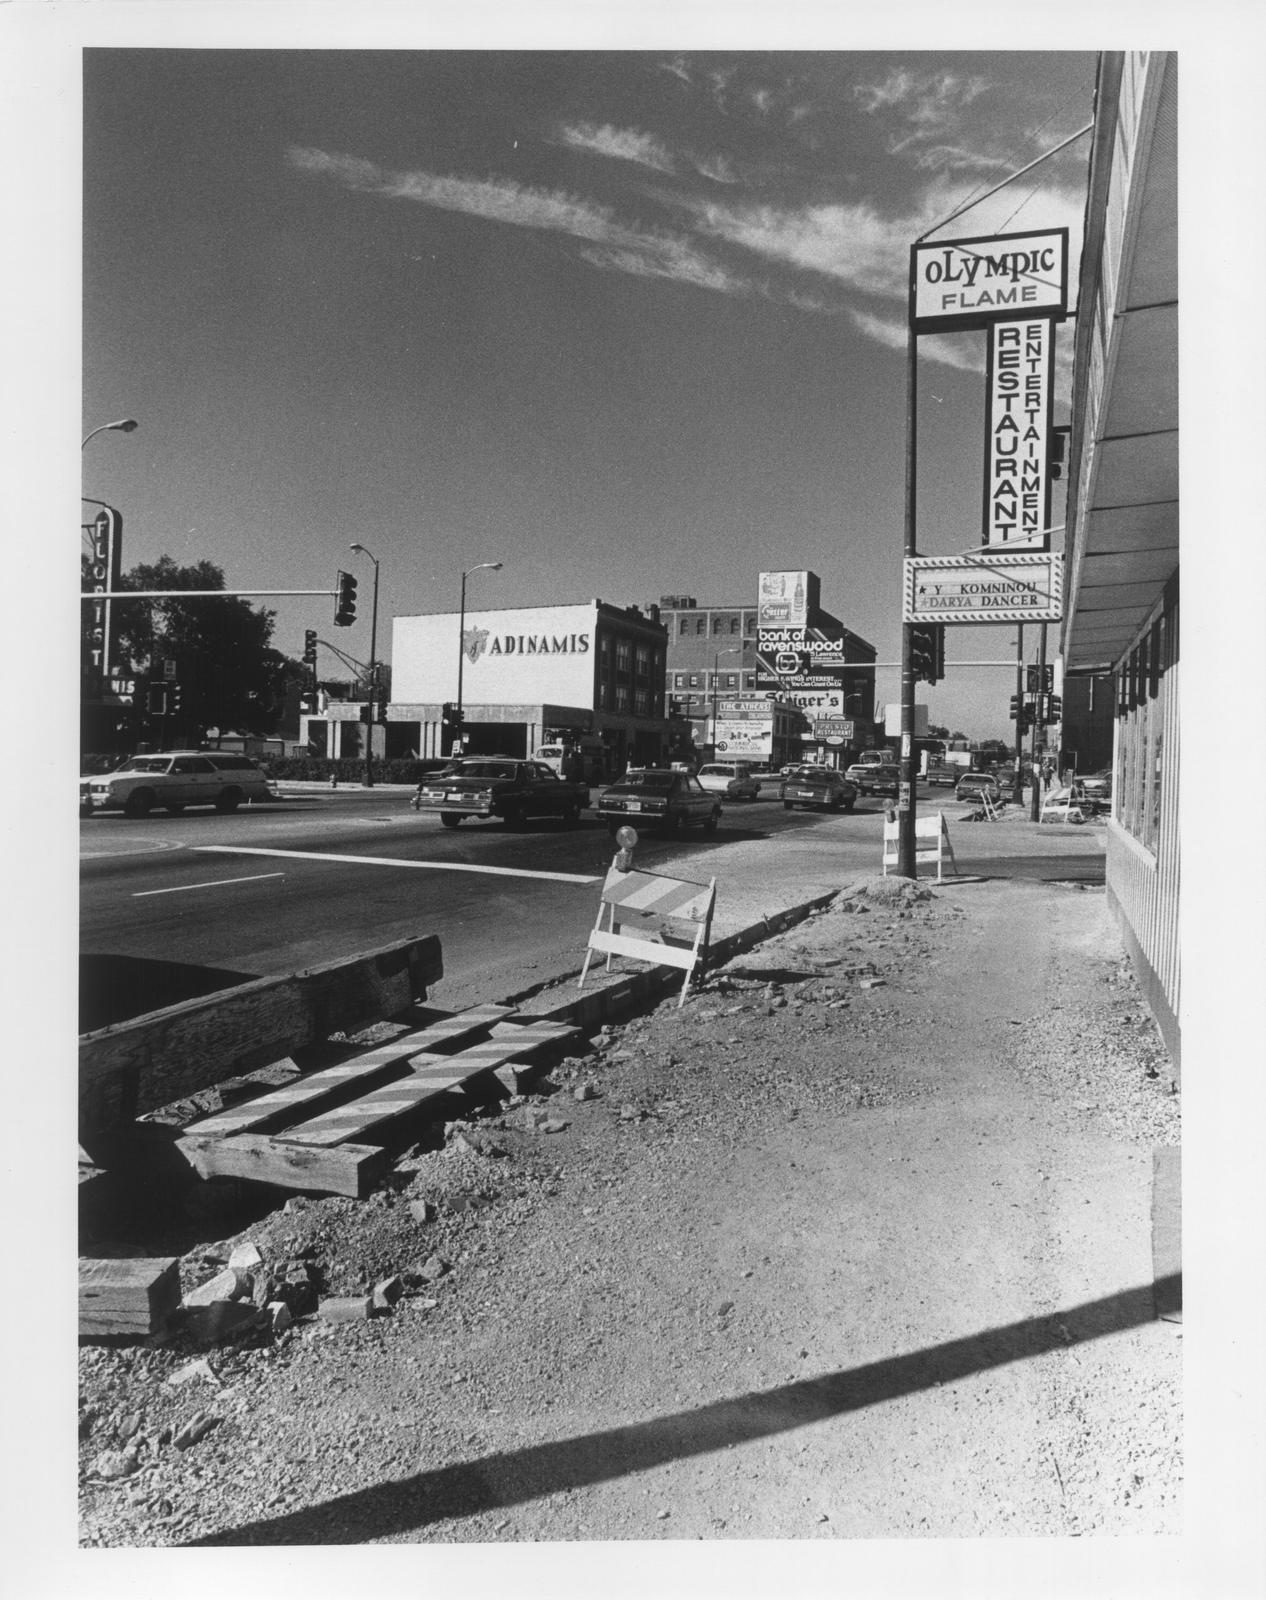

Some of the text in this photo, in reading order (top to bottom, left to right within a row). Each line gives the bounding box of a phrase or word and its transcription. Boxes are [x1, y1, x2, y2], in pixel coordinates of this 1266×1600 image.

[942, 285, 1038, 310] FLAME
[993, 327, 1021, 541] RESTAURANT
[1021, 324, 1042, 542] ENTERTAINMENT
[934, 582, 1036, 595] Y KOMNINOU
[930, 595, 1038, 608] DARYA DANCER
[758, 628, 805, 641] bank of
[491, 634, 590, 656] ADINAMIS
[758, 638, 843, 652] ravenswood
